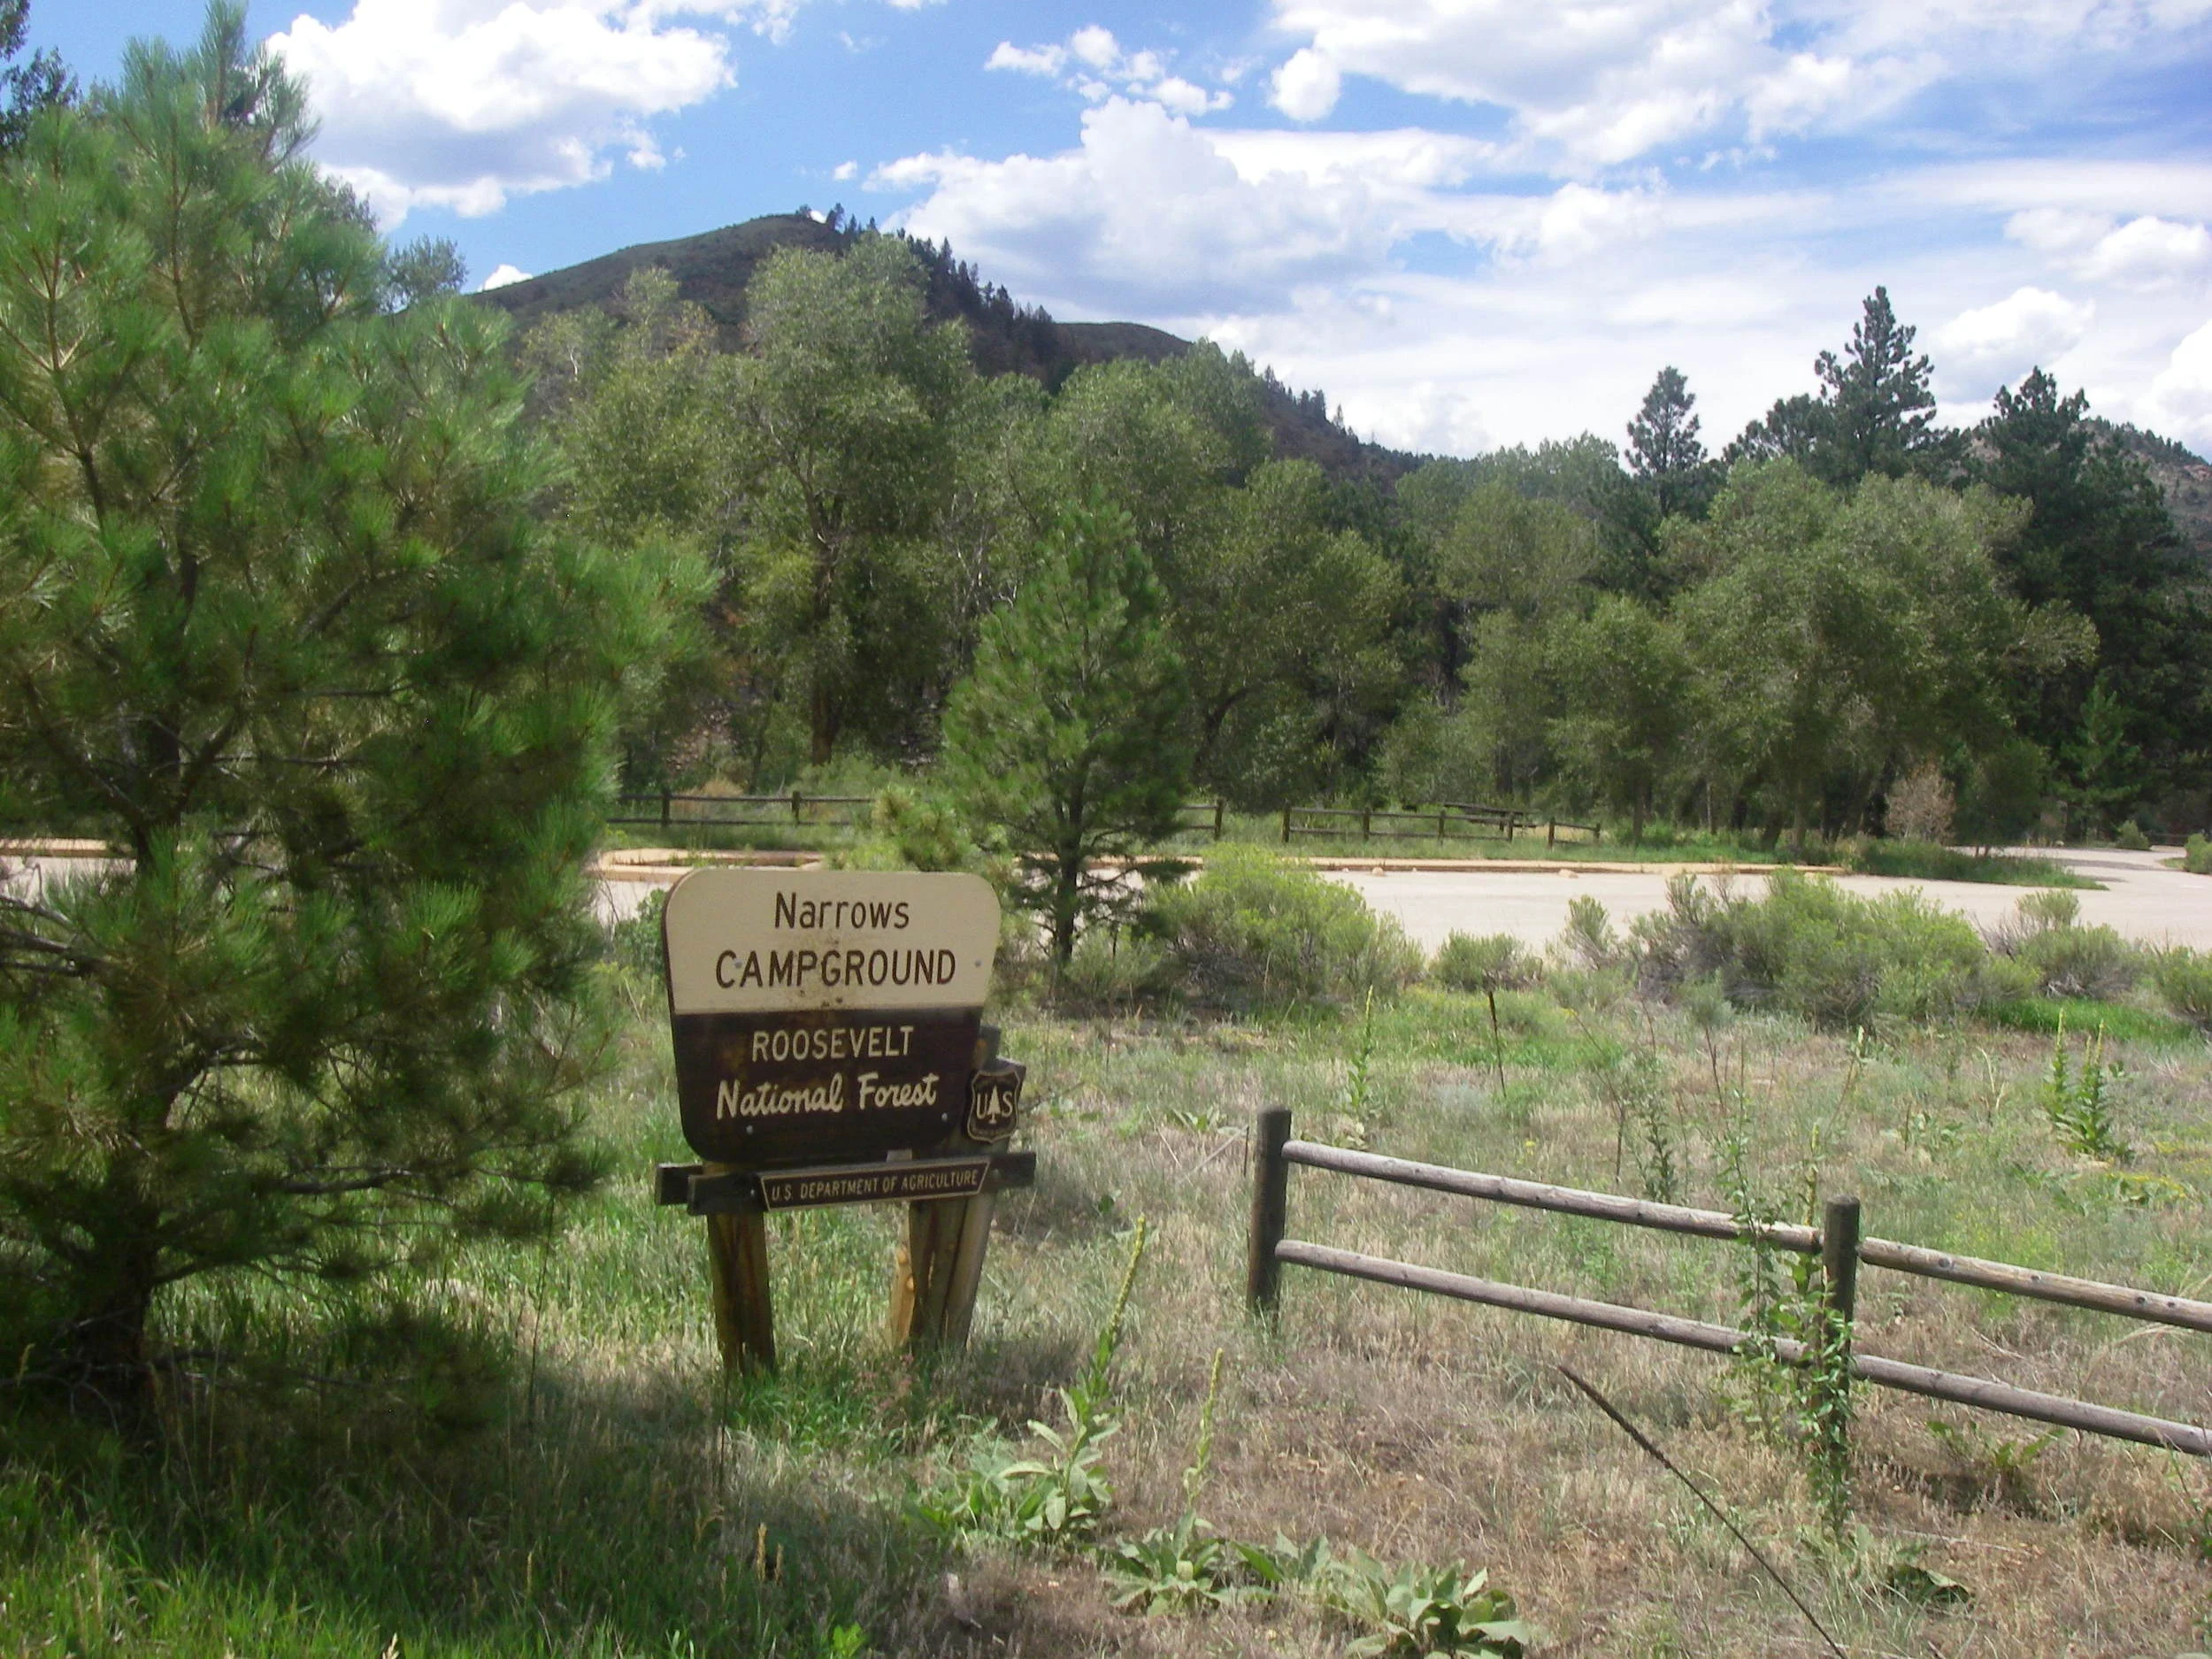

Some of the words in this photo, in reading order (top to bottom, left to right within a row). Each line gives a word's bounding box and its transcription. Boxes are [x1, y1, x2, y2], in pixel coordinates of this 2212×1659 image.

[775, 891, 910, 929] Narrows
[716, 949, 956, 988] CAMPGROUND
[752, 1025, 914, 1062] ROOSEVELT
[717, 1071, 844, 1120] National
[857, 1072, 941, 1110] Forest
[800, 1177, 879, 1200] DEPARTMENT
[882, 1175, 897, 1194] OF
[901, 1168, 978, 1191] AGRICULTURE
